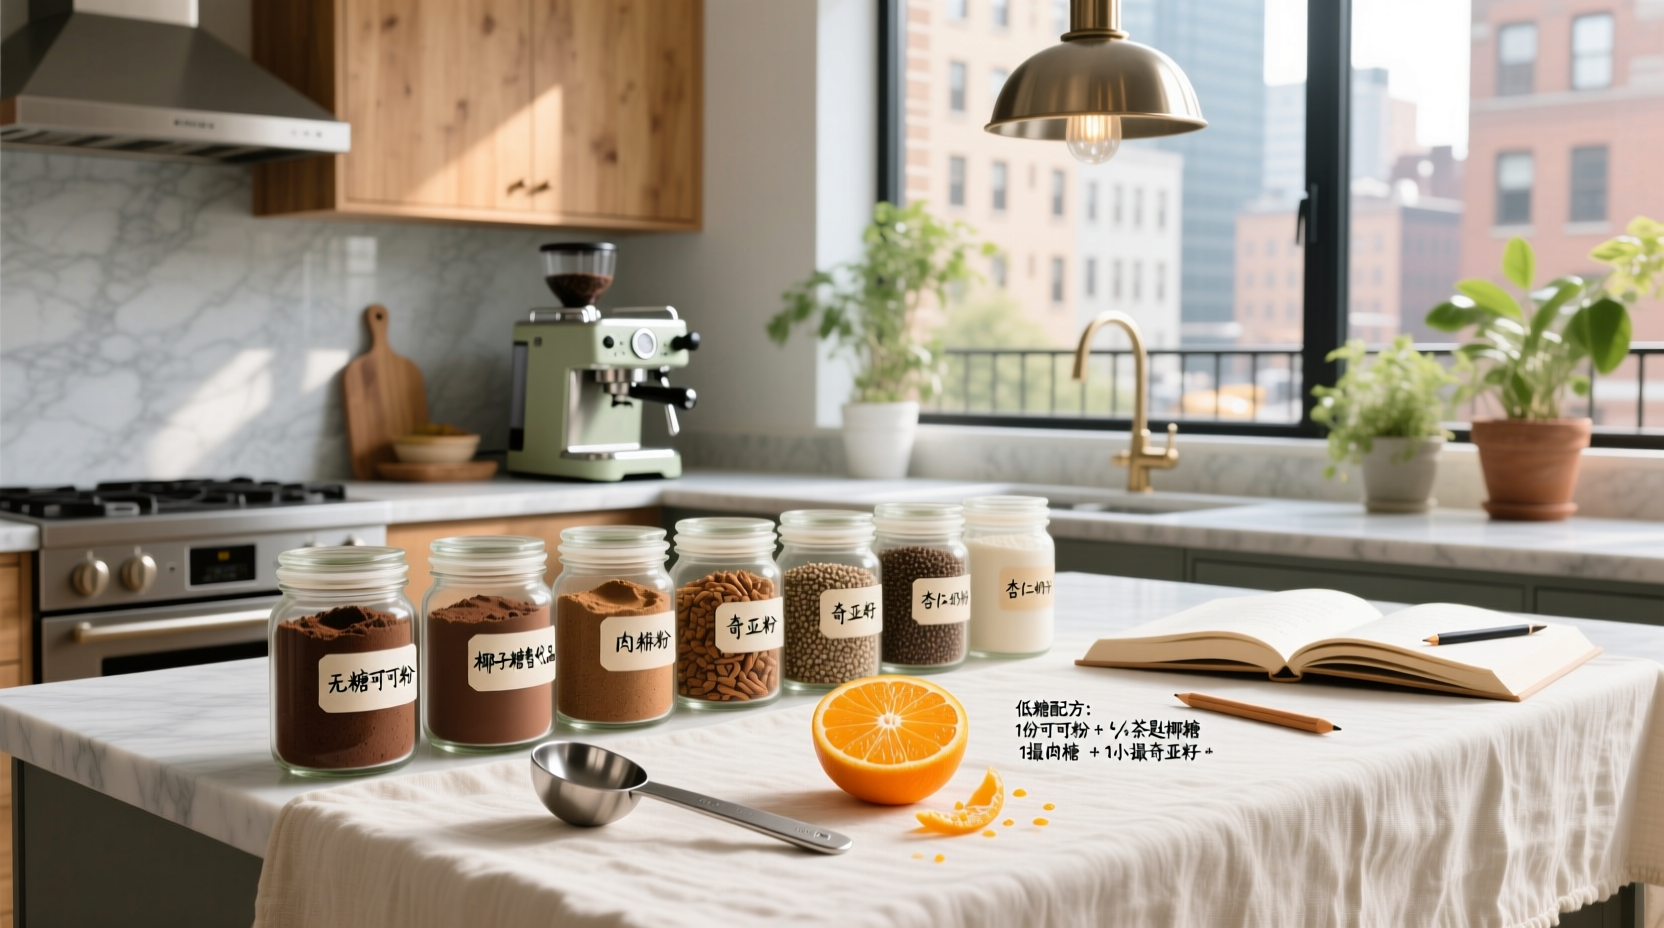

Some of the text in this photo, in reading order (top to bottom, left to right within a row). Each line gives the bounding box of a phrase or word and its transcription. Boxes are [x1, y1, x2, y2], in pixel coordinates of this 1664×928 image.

[727, 614, 777, 640] 奇亚粉
[328, 664, 416, 693] 无糖可可粉
